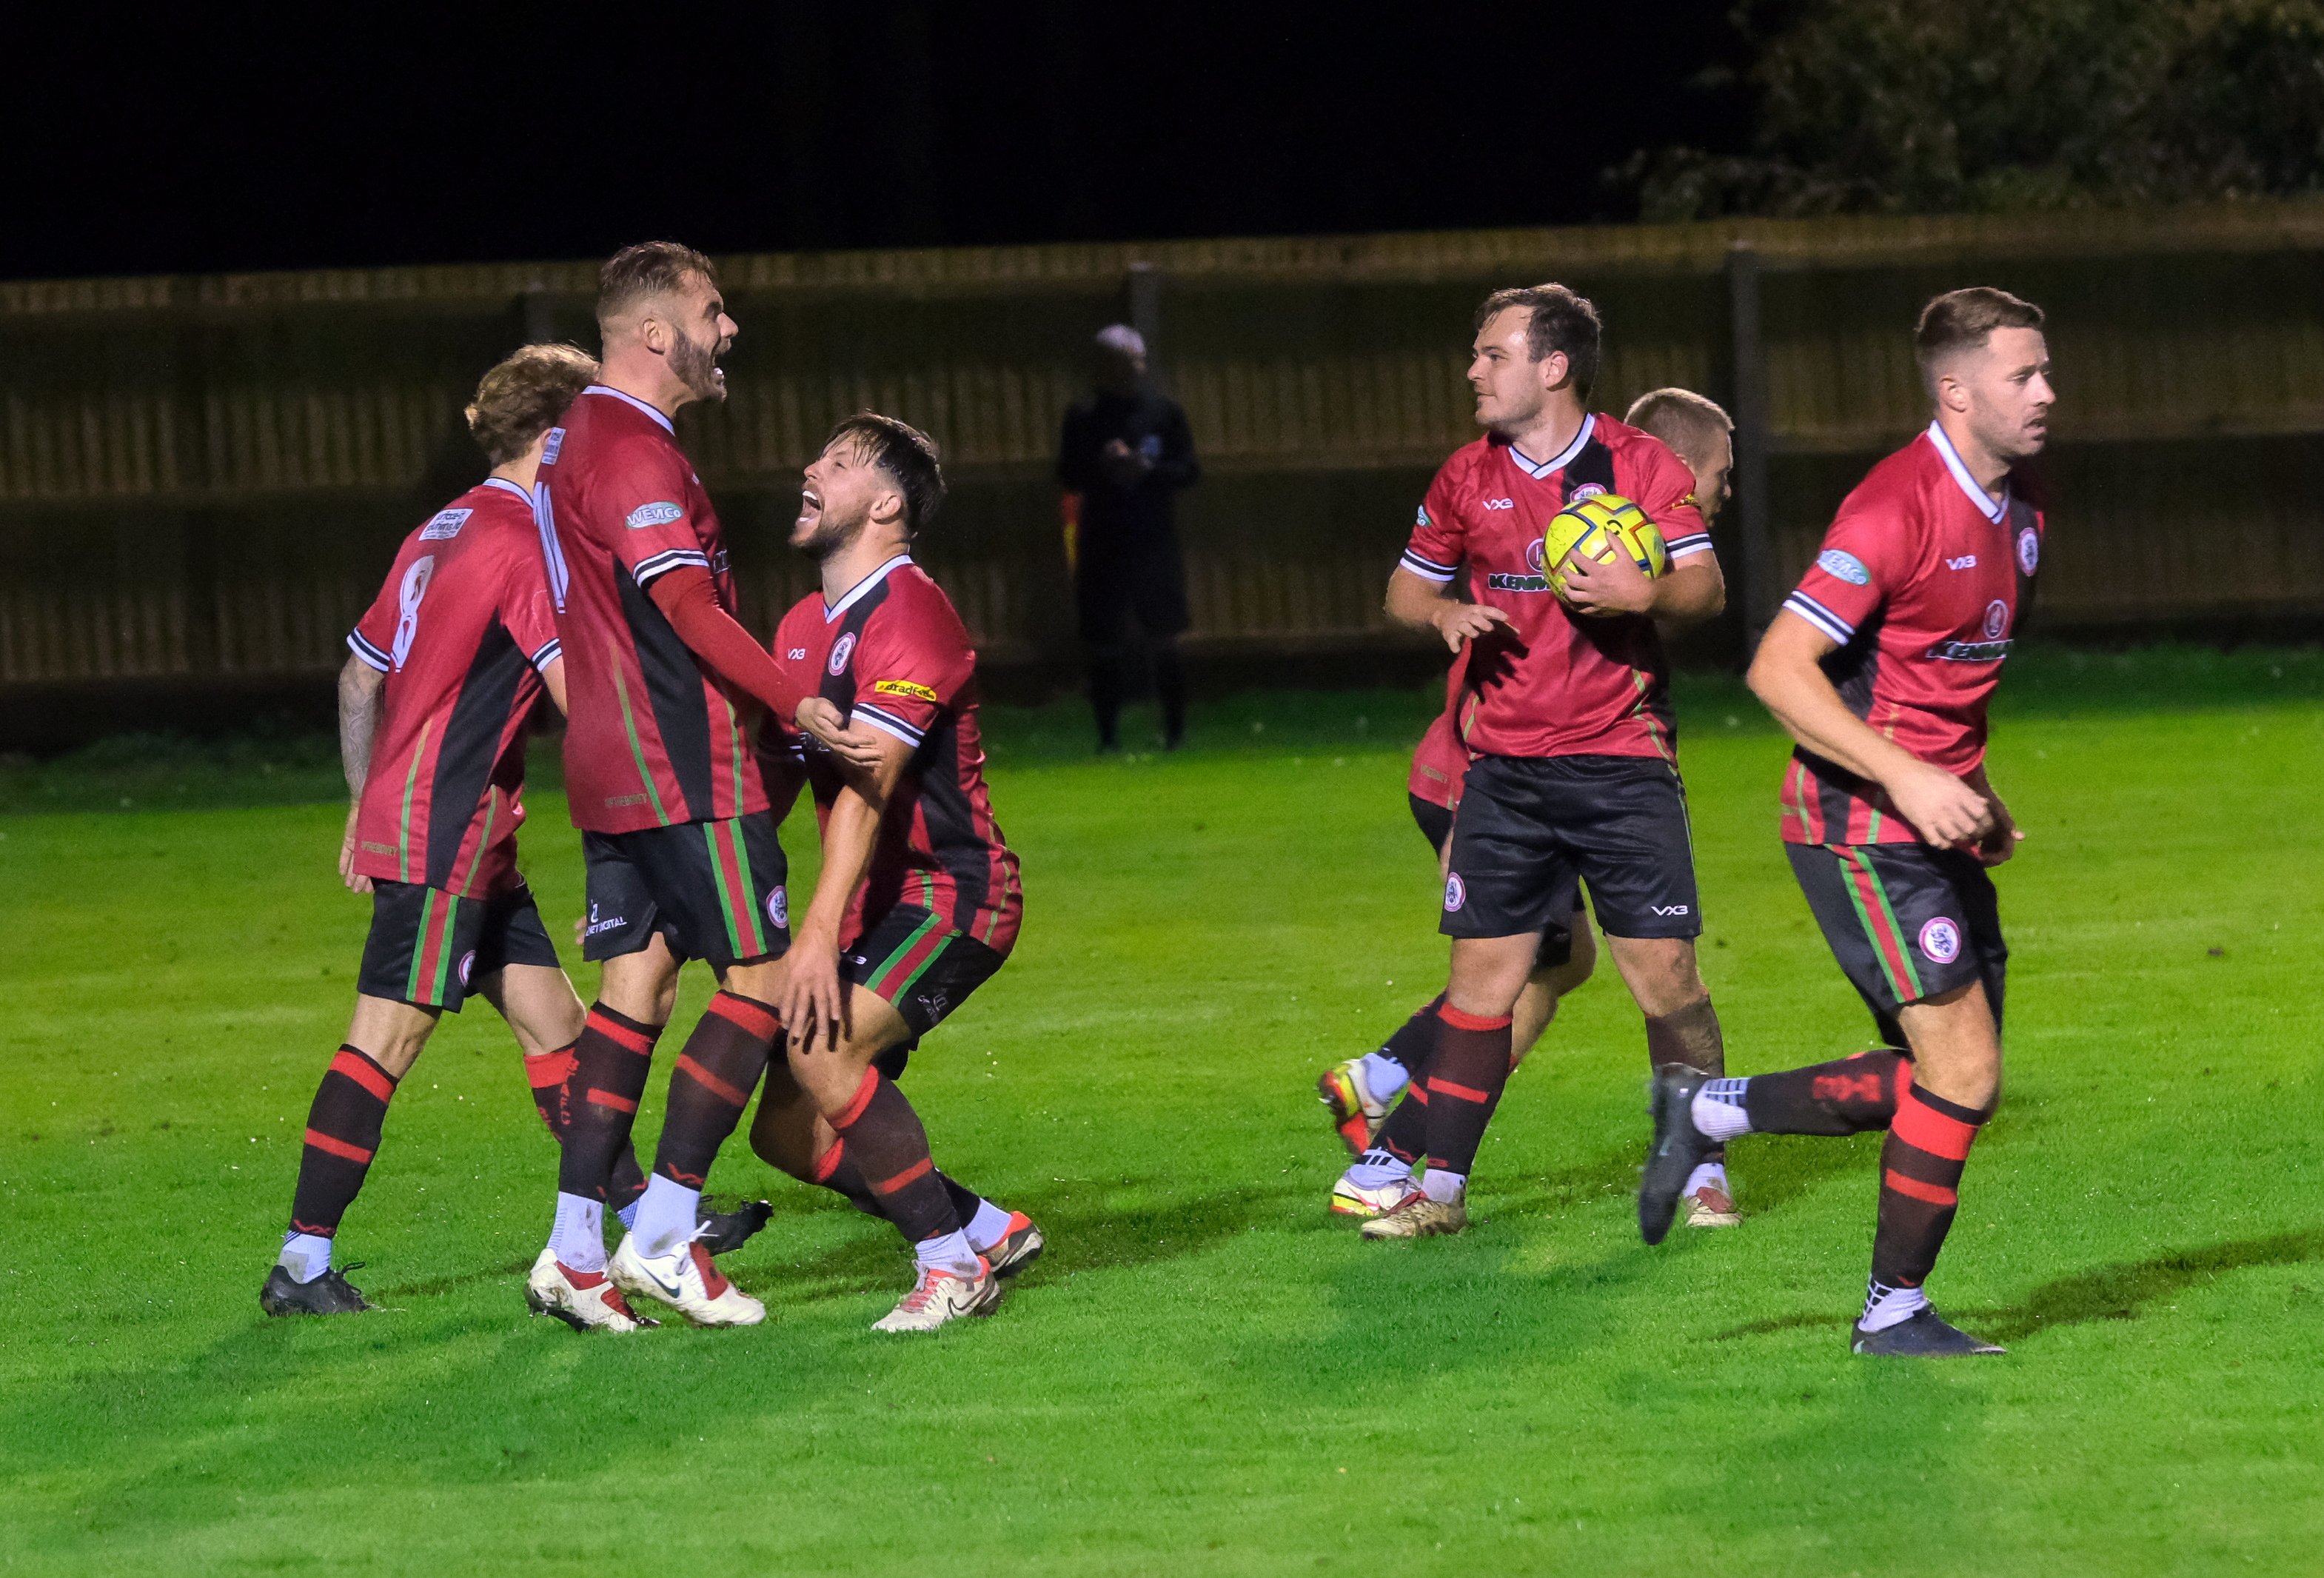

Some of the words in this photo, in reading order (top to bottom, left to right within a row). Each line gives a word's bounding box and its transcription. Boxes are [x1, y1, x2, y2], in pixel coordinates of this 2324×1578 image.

[1482, 498, 1514, 510] VX3
[390, 555, 435, 672] 8
[1650, 905, 1688, 916] VX3
